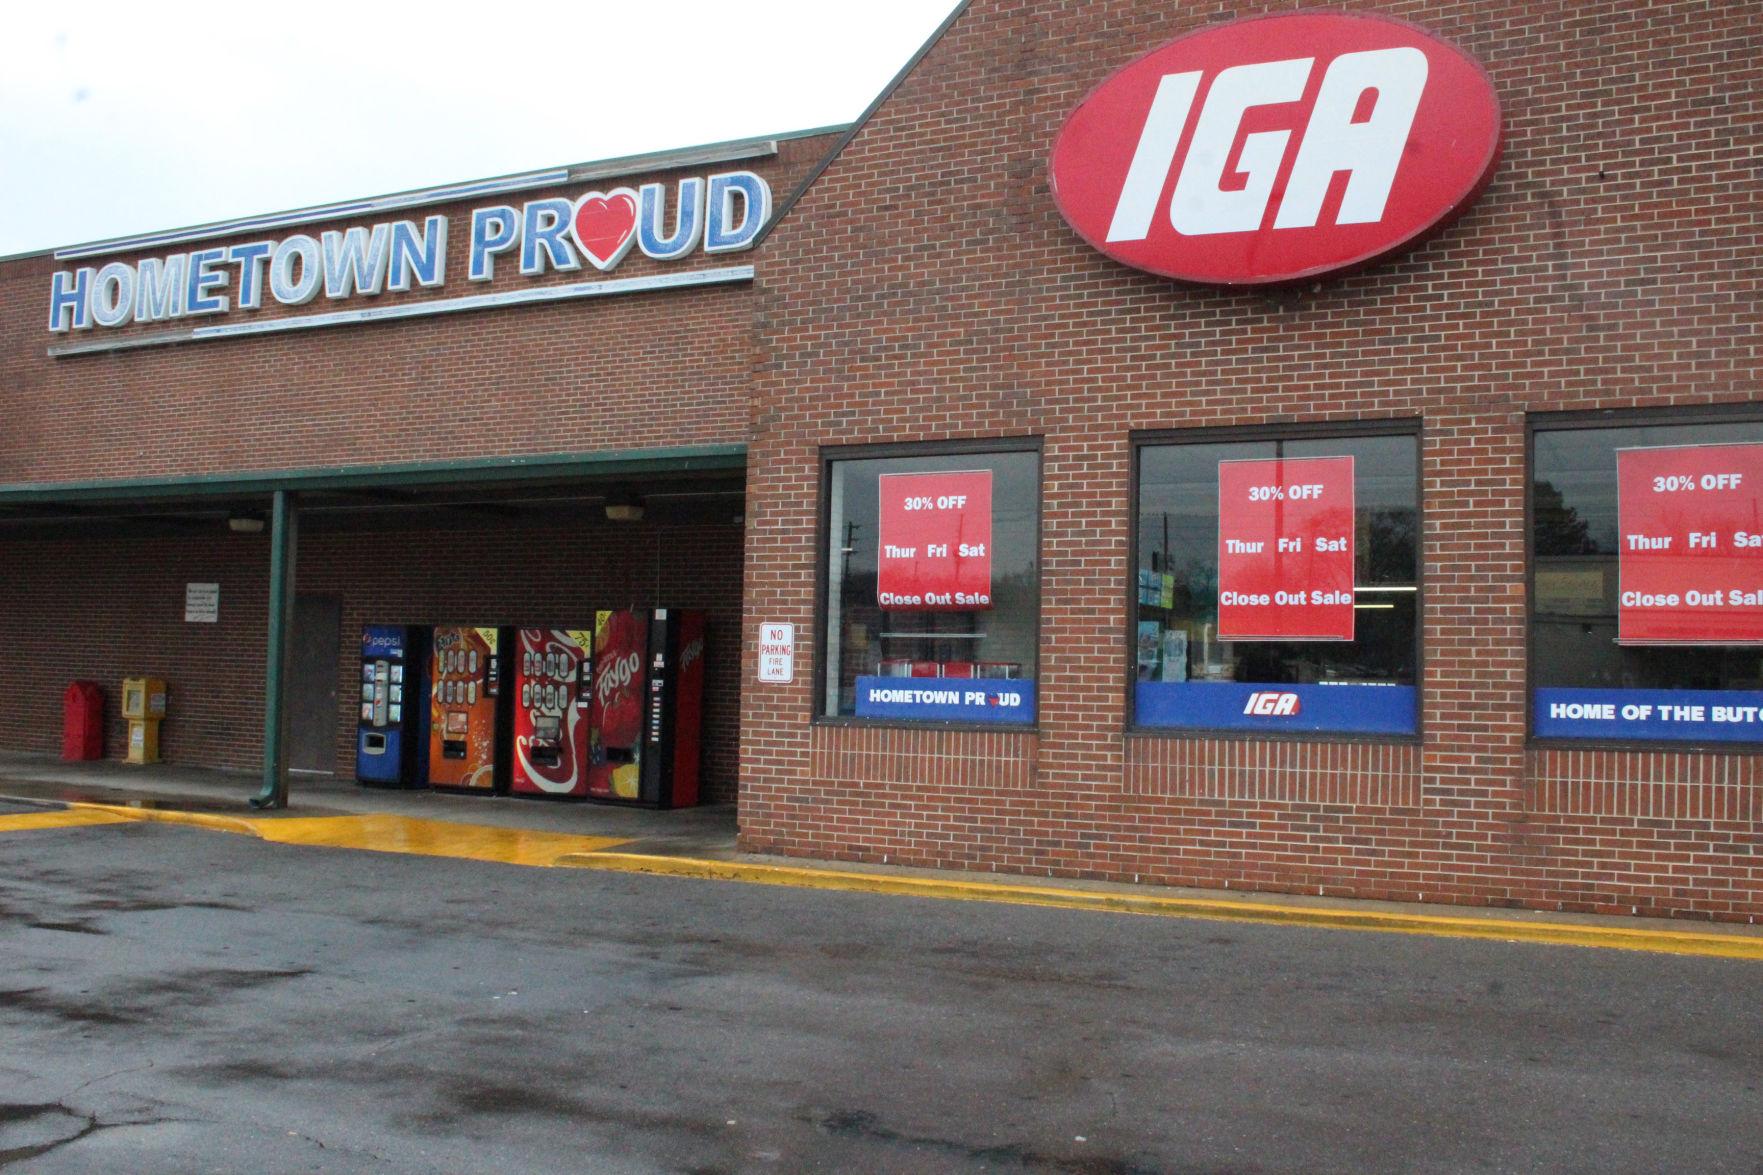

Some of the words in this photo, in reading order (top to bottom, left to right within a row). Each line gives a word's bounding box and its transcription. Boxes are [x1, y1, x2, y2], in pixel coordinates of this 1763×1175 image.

[1105, 46, 1429, 243] IGA
[49, 212, 448, 333] HOMETOWN
[468, 170, 773, 281] PRUD
[1653, 475, 1695, 493] 30%
[1700, 473, 1742, 490] OFF
[1248, 485, 1285, 502] 30%
[1288, 484, 1324, 500] OFF
[903, 496, 934, 511] 30%
[936, 495, 967, 510] OFF
[1225, 539, 1265, 554] Thur
[1278, 537, 1301, 553] Fri
[1315, 536, 1347, 552] Sat
[1627, 534, 1672, 550] Thur
[1689, 532, 1716, 548] Fri
[884, 544, 917, 559] Thur
[927, 543, 948, 558] Fri
[958, 543, 986, 558] Sat
[879, 592, 921, 606] Close
[924, 592, 952, 606] Out
[954, 591, 989, 605] Sale
[1220, 591, 1270, 606] Close
[1274, 590, 1307, 606] Out
[1311, 590, 1352, 606] Sale
[1621, 590, 1680, 607] Close
[1685, 590, 1724, 606] Out
[372, 636, 401, 647] pepsi
[770, 629, 783, 641] NO
[761, 644, 791, 656] PARKING
[768, 657, 783, 666] FIRE
[596, 652, 640, 706] Faygo
[767, 667, 784, 676] LANE
[868, 688, 960, 705] HOMETOWN
[1243, 692, 1298, 716] IGA
[1550, 703, 1616, 720] HOME
[1621, 704, 1653, 721] OF
[1657, 705, 1705, 722] THE
